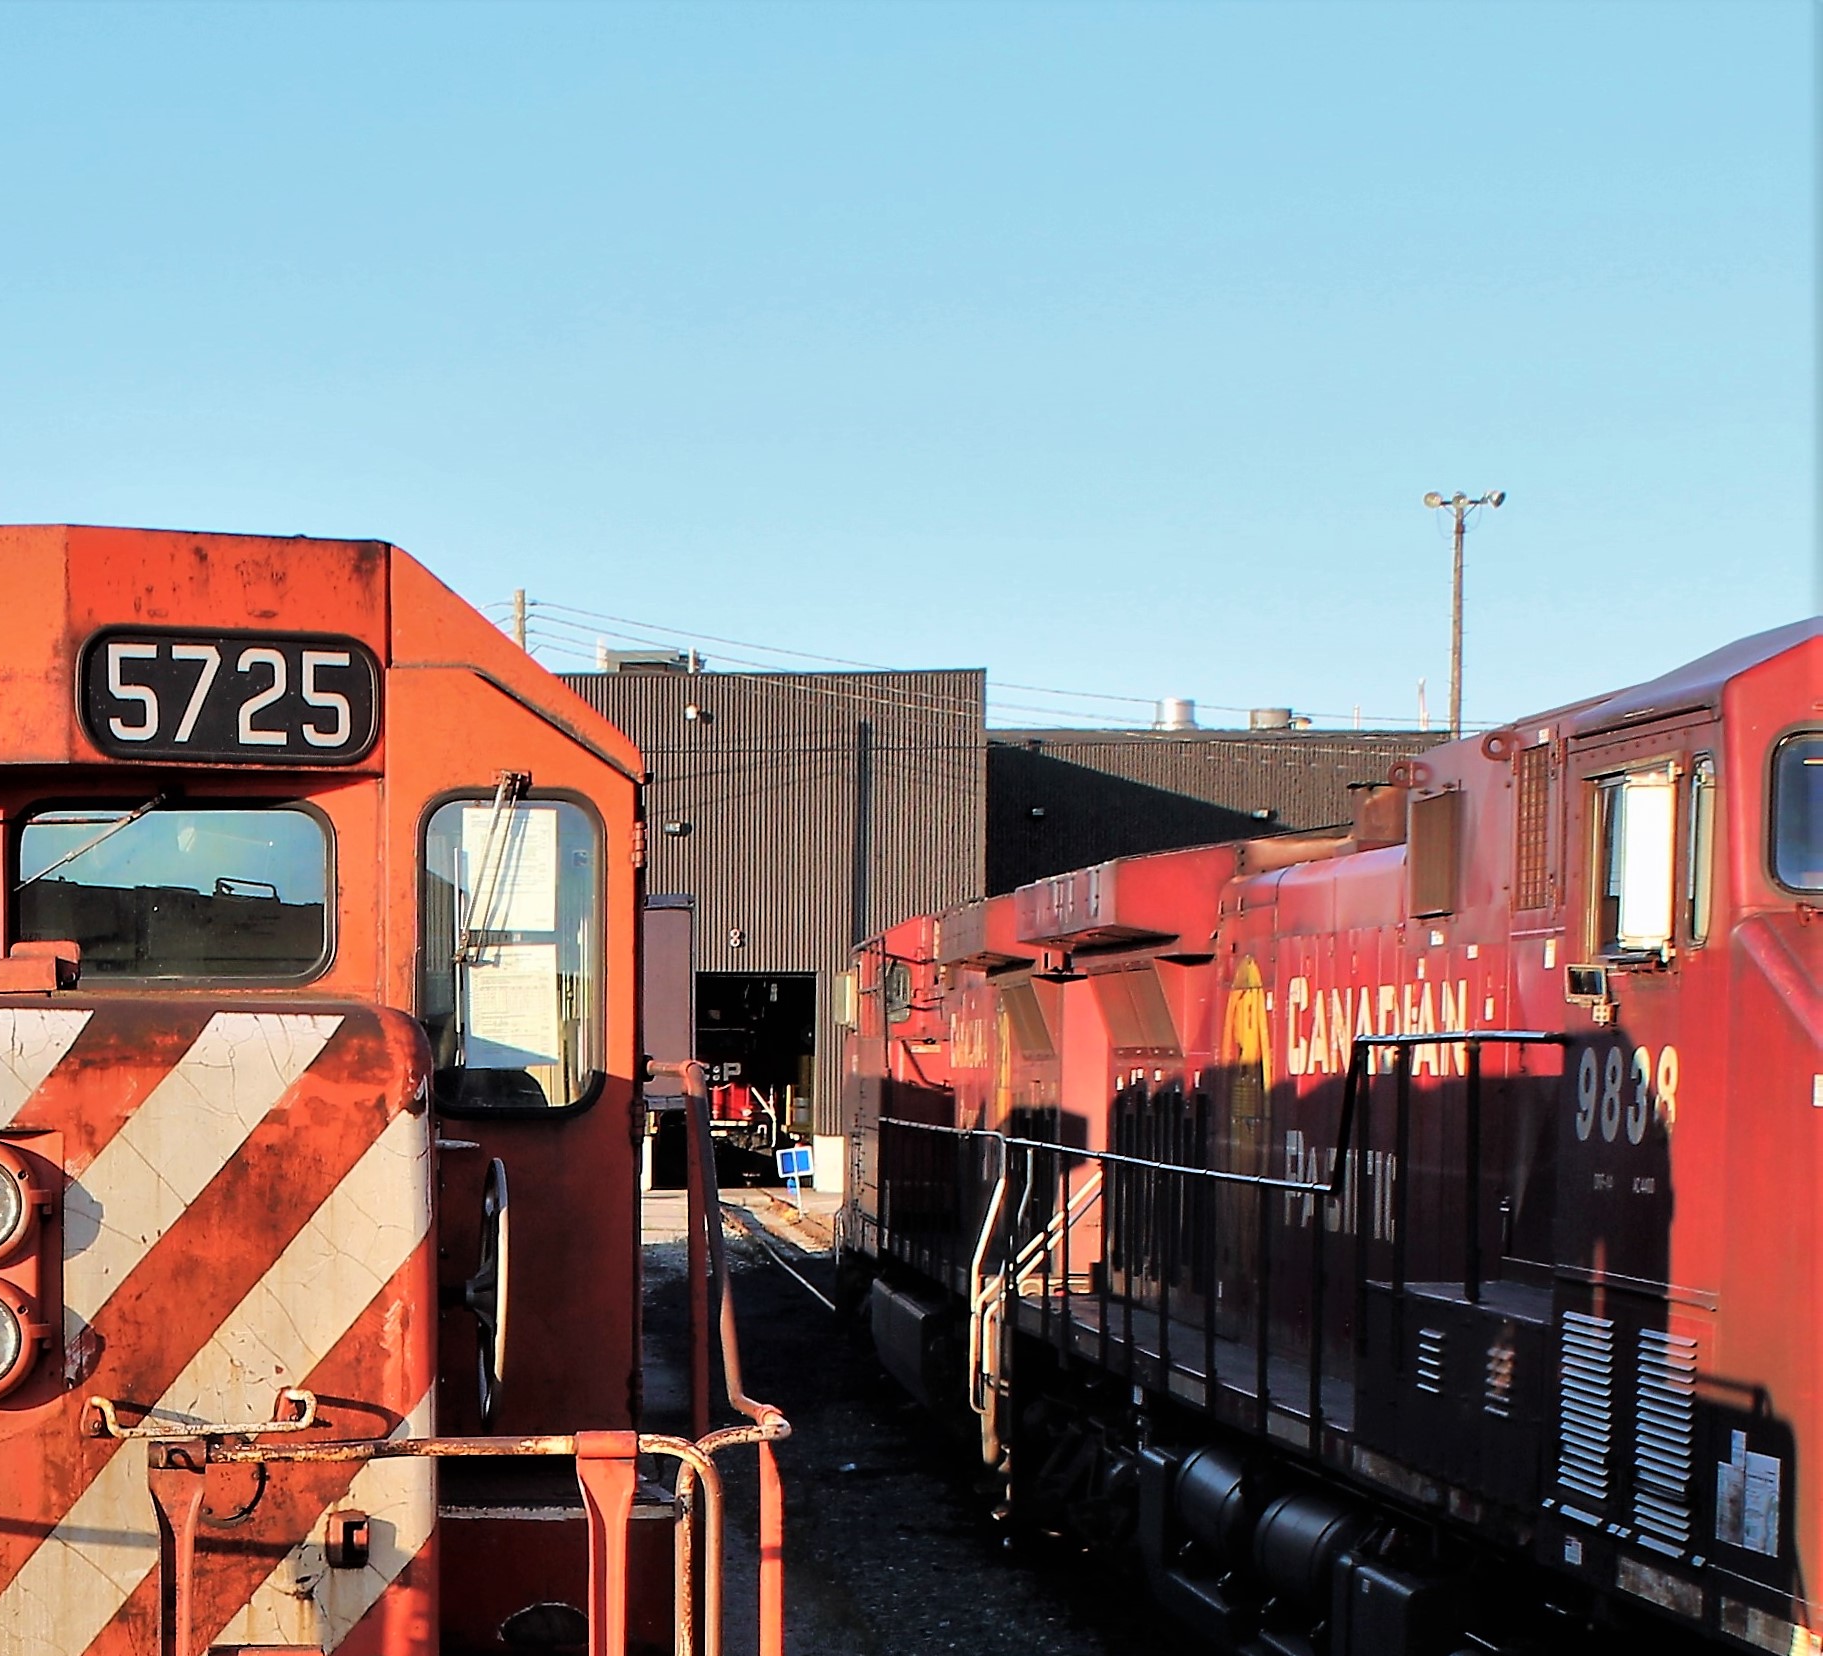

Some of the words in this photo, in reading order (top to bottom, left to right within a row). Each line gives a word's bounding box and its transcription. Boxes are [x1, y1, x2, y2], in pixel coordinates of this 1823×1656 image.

[107, 643, 351, 748] 5725
[730, 928, 741, 948] 8
[1287, 976, 1468, 1076] CANADIAN
[1576, 1045, 1679, 1145] 9838
